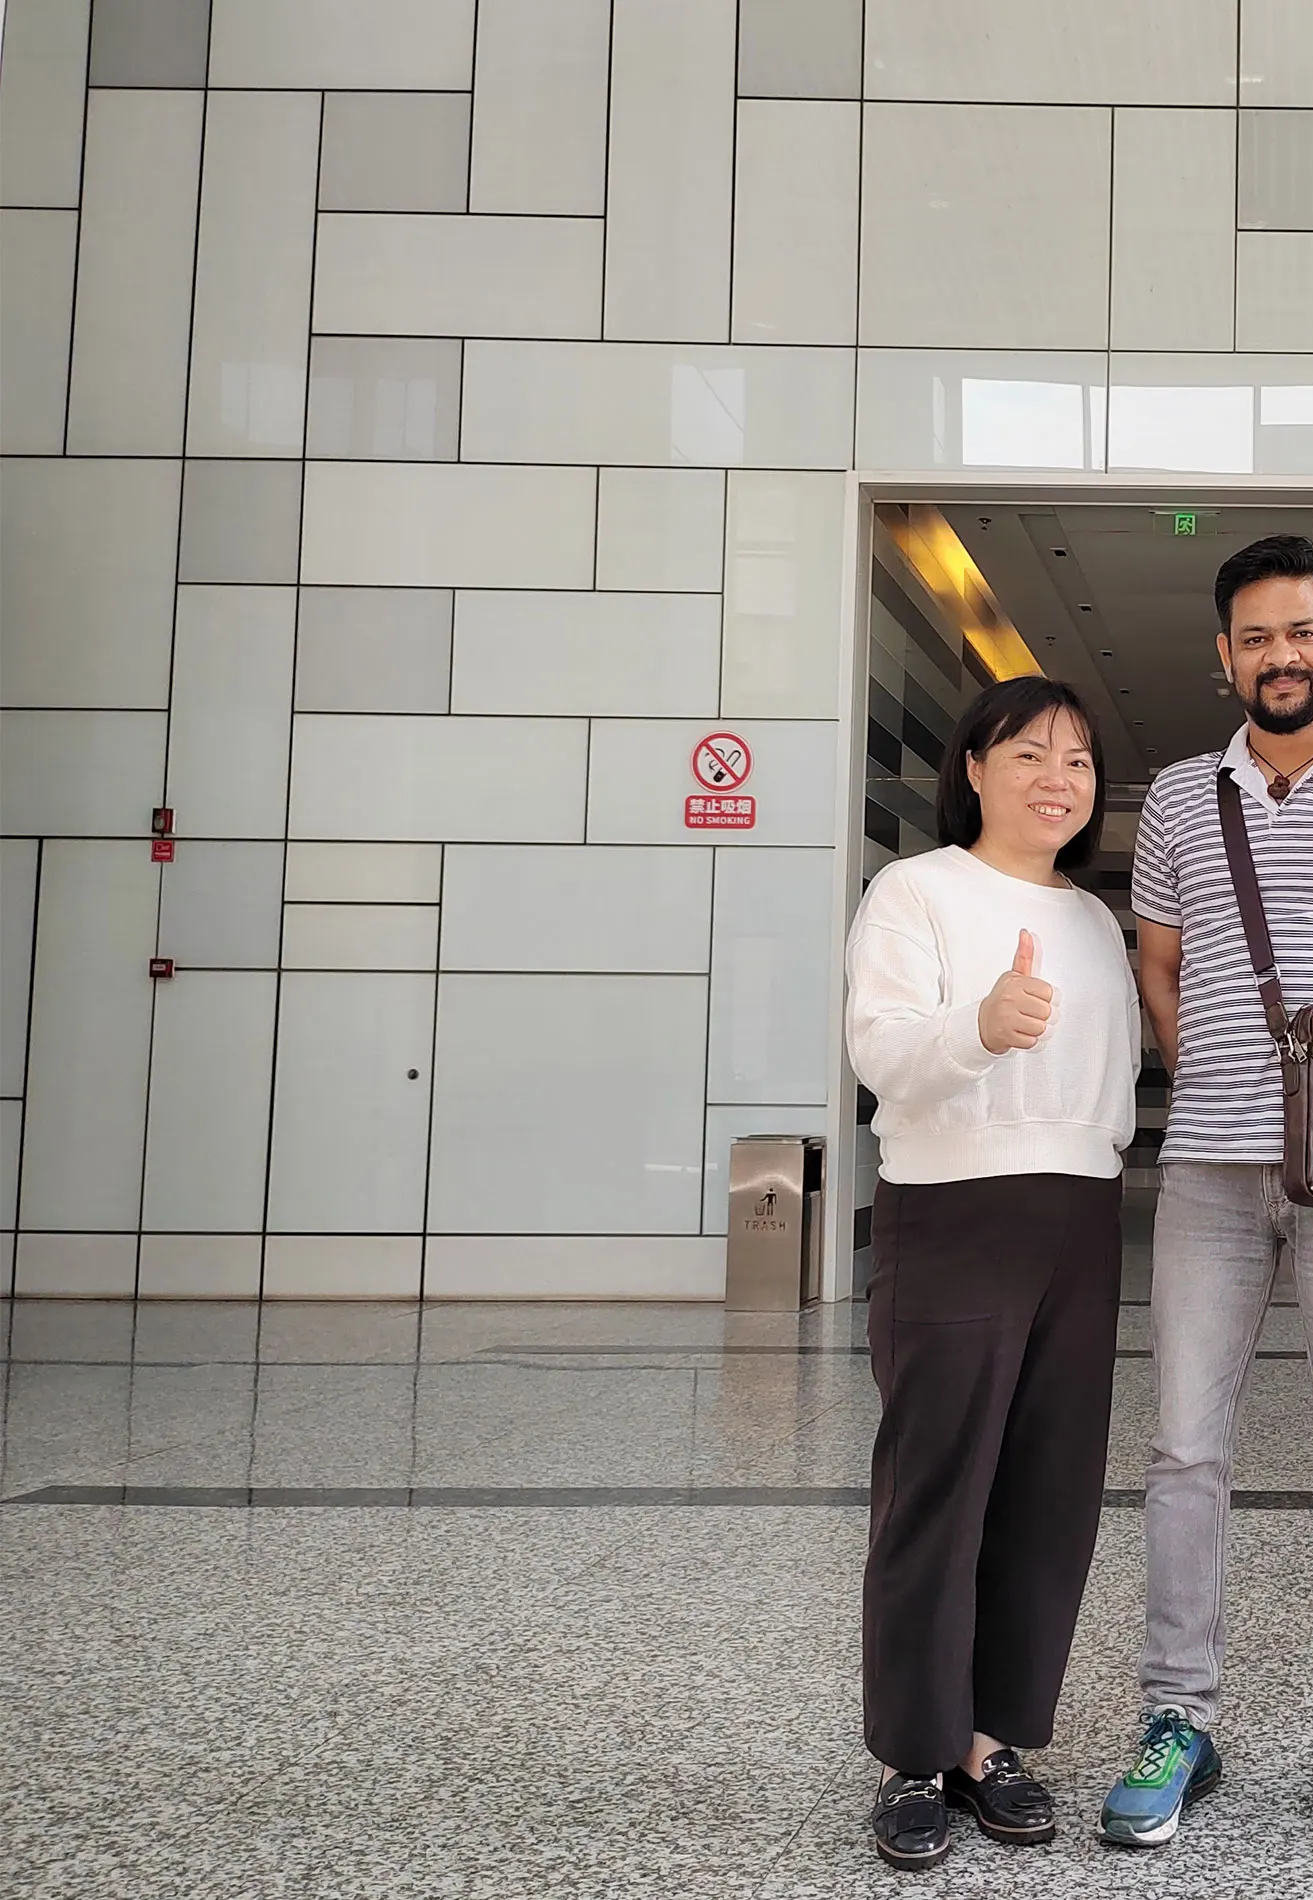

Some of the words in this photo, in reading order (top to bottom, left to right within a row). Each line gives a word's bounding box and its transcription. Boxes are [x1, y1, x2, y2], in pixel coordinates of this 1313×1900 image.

[689, 799, 752, 814] 禁止吸烟
[689, 816, 704, 824] NO
[705, 816, 751, 825] SMOKING
[744, 1220, 786, 1232] TRASH
